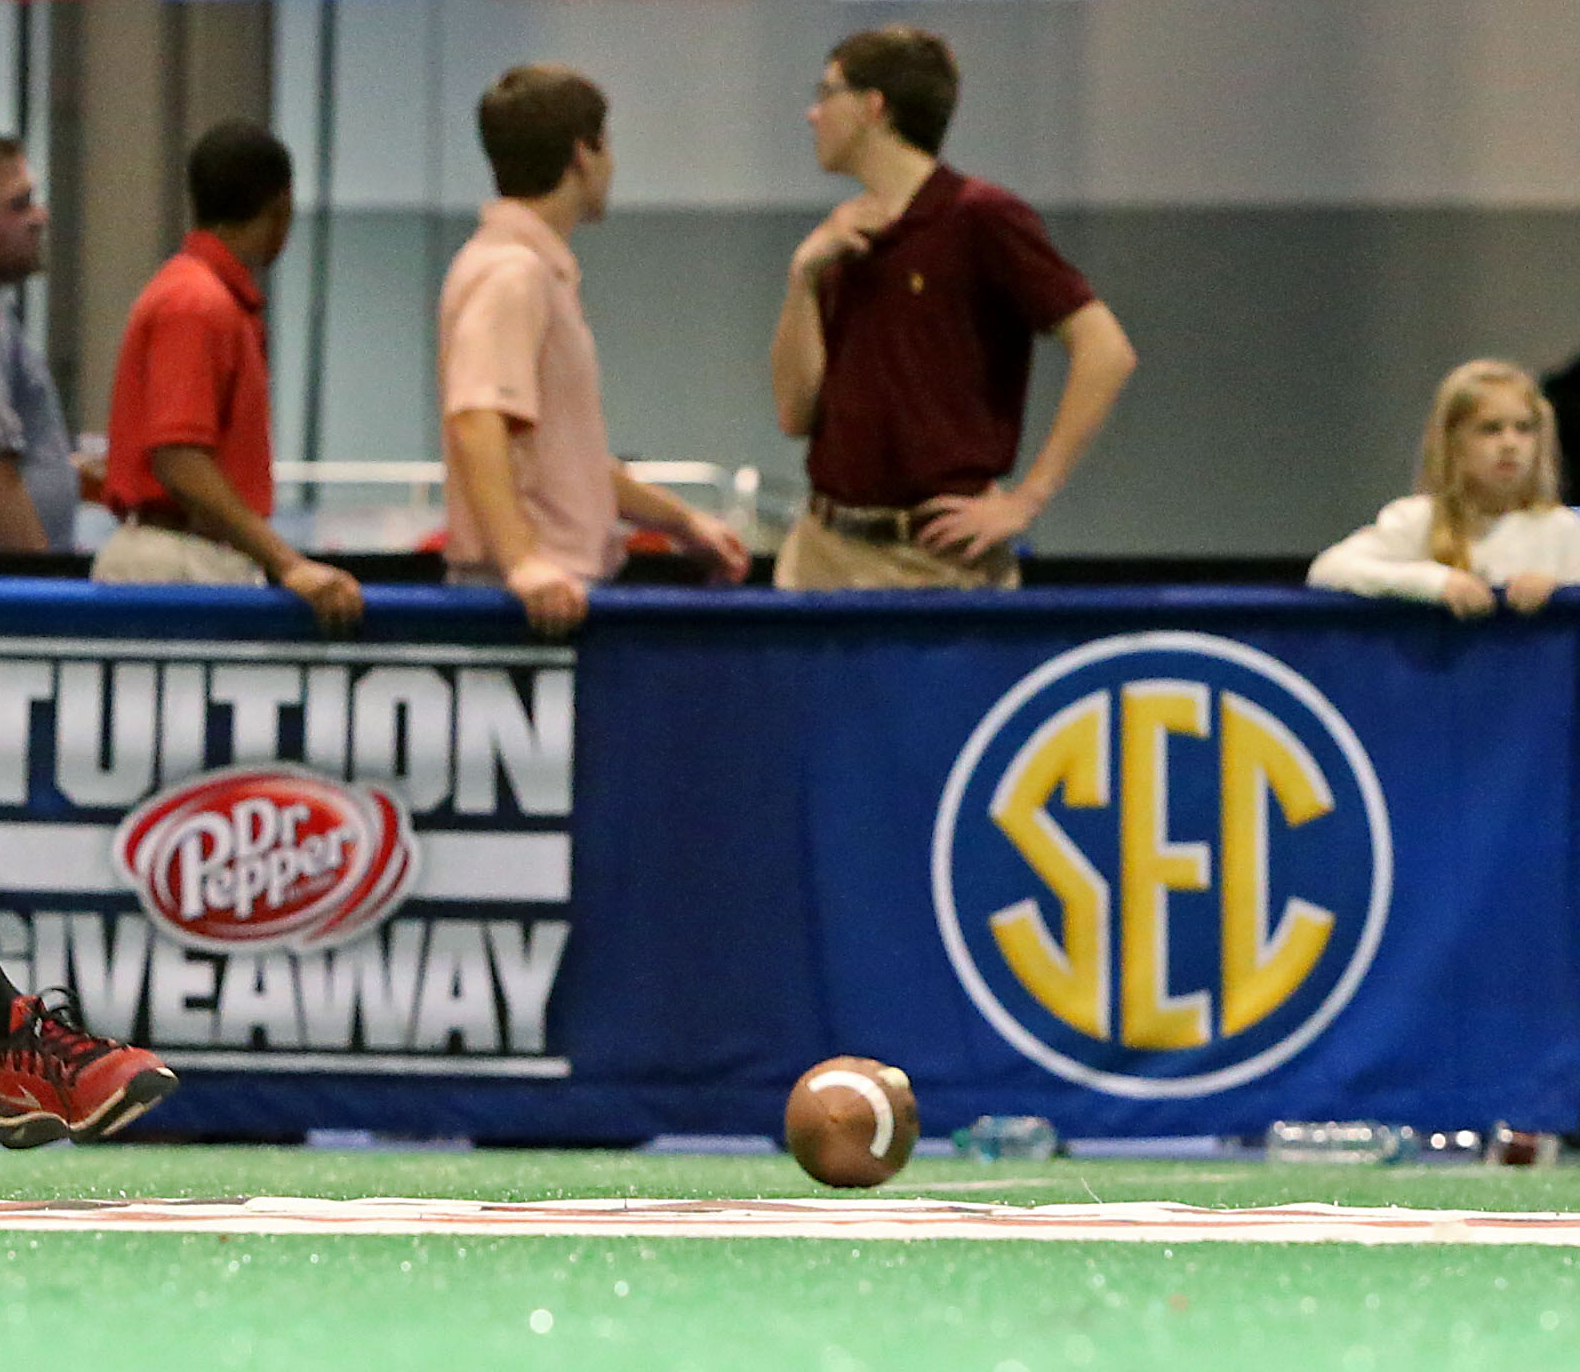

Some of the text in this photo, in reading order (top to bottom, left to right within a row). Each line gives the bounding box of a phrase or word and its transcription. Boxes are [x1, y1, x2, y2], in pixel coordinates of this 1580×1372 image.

[177, 809, 359, 922] Pepper
[233, 796, 311, 857] Dr
[989, 678, 1336, 1052] SEC
